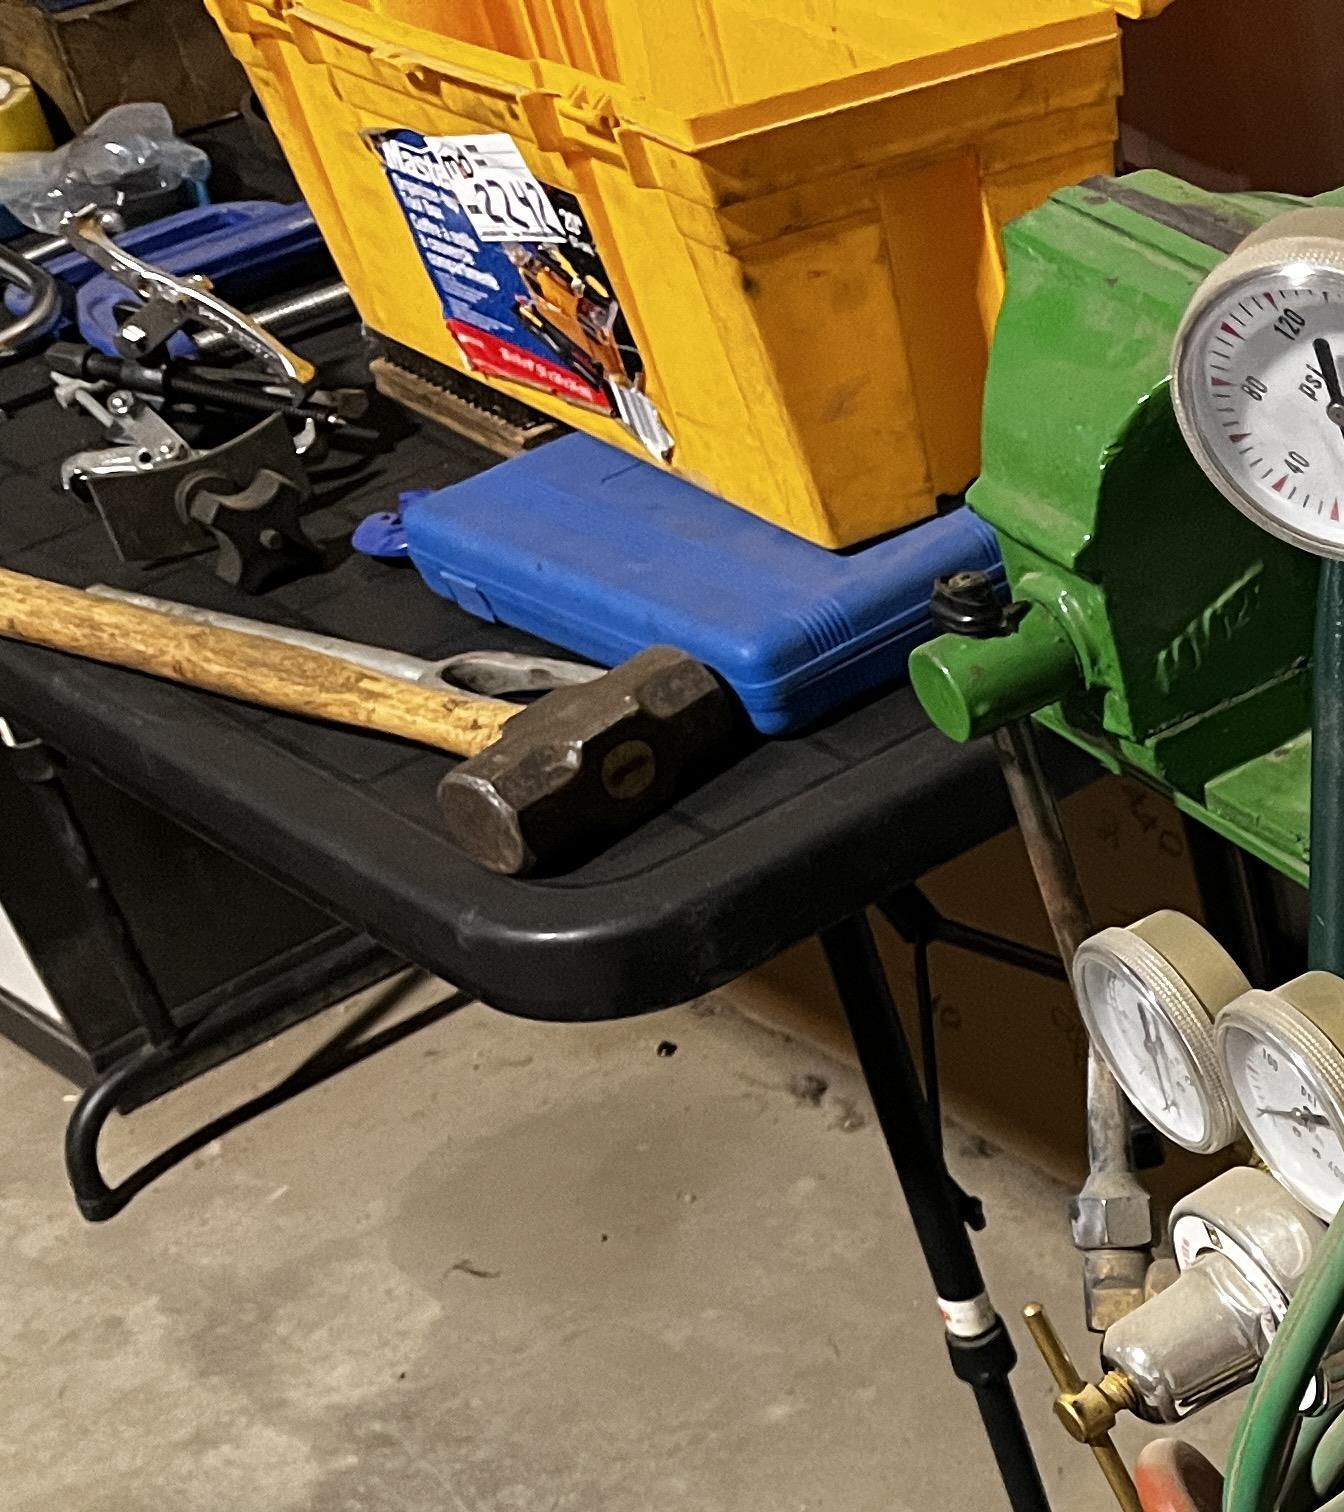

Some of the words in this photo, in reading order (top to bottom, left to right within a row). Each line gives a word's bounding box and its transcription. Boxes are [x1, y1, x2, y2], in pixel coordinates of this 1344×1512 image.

[474, 179, 567, 237] 2242
[1273, 307, 1306, 341] 120
[1240, 375, 1268, 401] 80
[1283, 451, 1311, 474] 40
